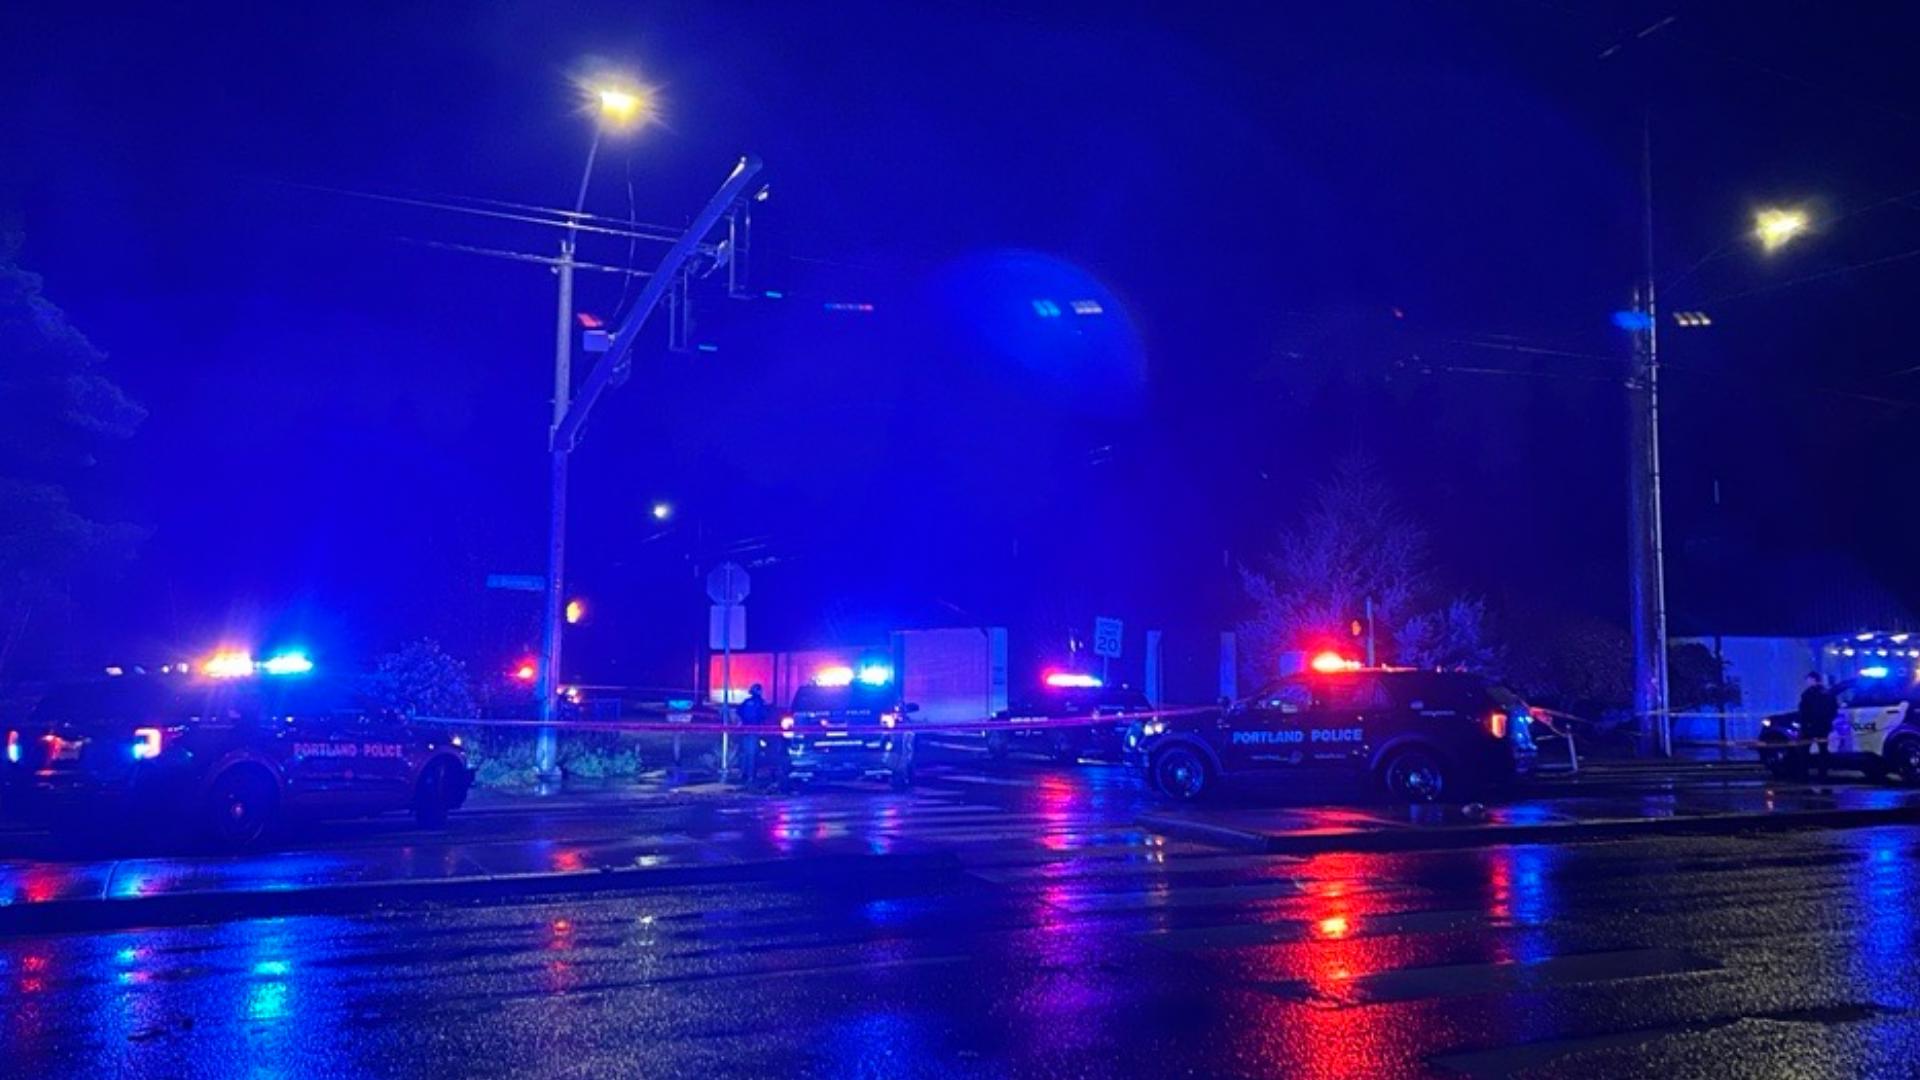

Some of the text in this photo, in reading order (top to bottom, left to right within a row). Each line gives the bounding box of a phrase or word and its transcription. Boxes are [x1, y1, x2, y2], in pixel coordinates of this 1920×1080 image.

[1097, 636, 1118, 652] 20
[1232, 728, 1364, 744] PORTLAND POLICE
[293, 743, 403, 758] PORTLAND POLICE
